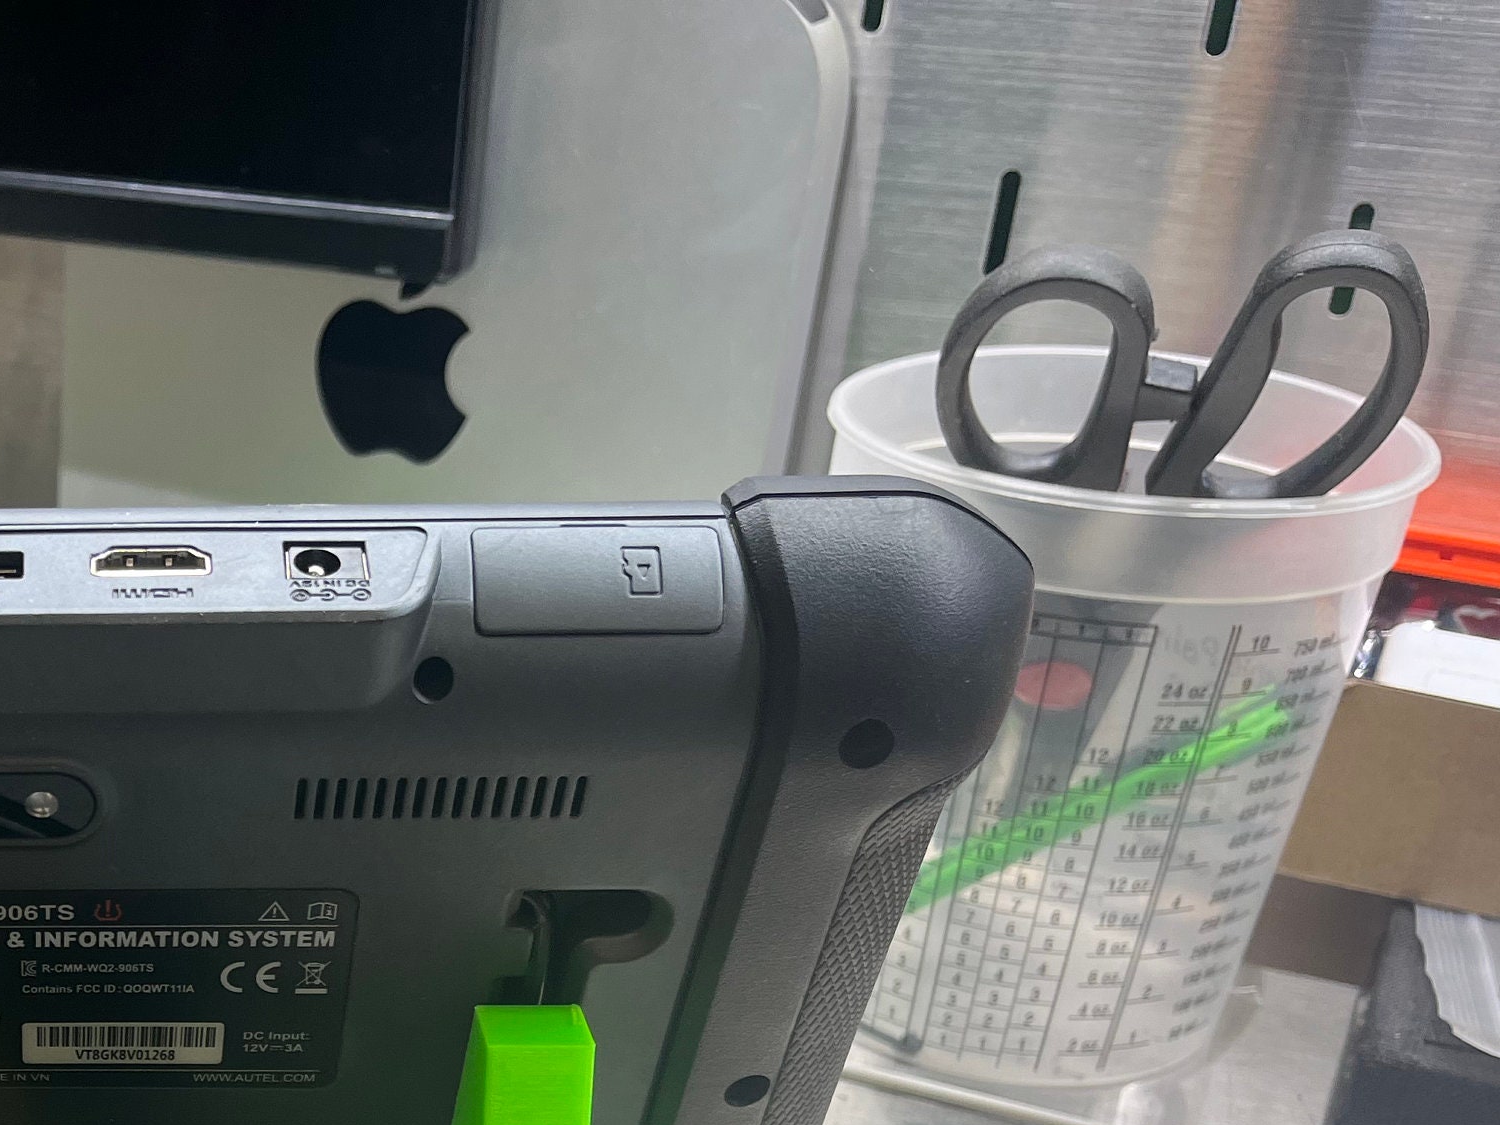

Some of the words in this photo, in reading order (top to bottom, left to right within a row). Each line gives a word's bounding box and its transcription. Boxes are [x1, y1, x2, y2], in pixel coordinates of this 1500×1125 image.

[1252, 634, 1270, 651] 10
[1161, 683, 1183, 699] 24
[6, 931, 25, 949] &
[34, 930, 219, 948] INFORMATION
[227, 930, 337, 948] SYSTEM
[41, 963, 155, 974] R-CMM-WQ2-906TS
[220, 961, 282, 993] CE
[21, 984, 73, 994] Contains
[76, 984, 100, 993] FCC
[242, 1031, 264, 1040] DC
[269, 1031, 311, 1043] Input:
[75, 1048, 176, 1061] VT8GK8V01268
[12, 1072, 27, 1081] IN
[30, 1072, 51, 1081] VN
[192, 1073, 317, 1083] WWW.AUTEL.COM
